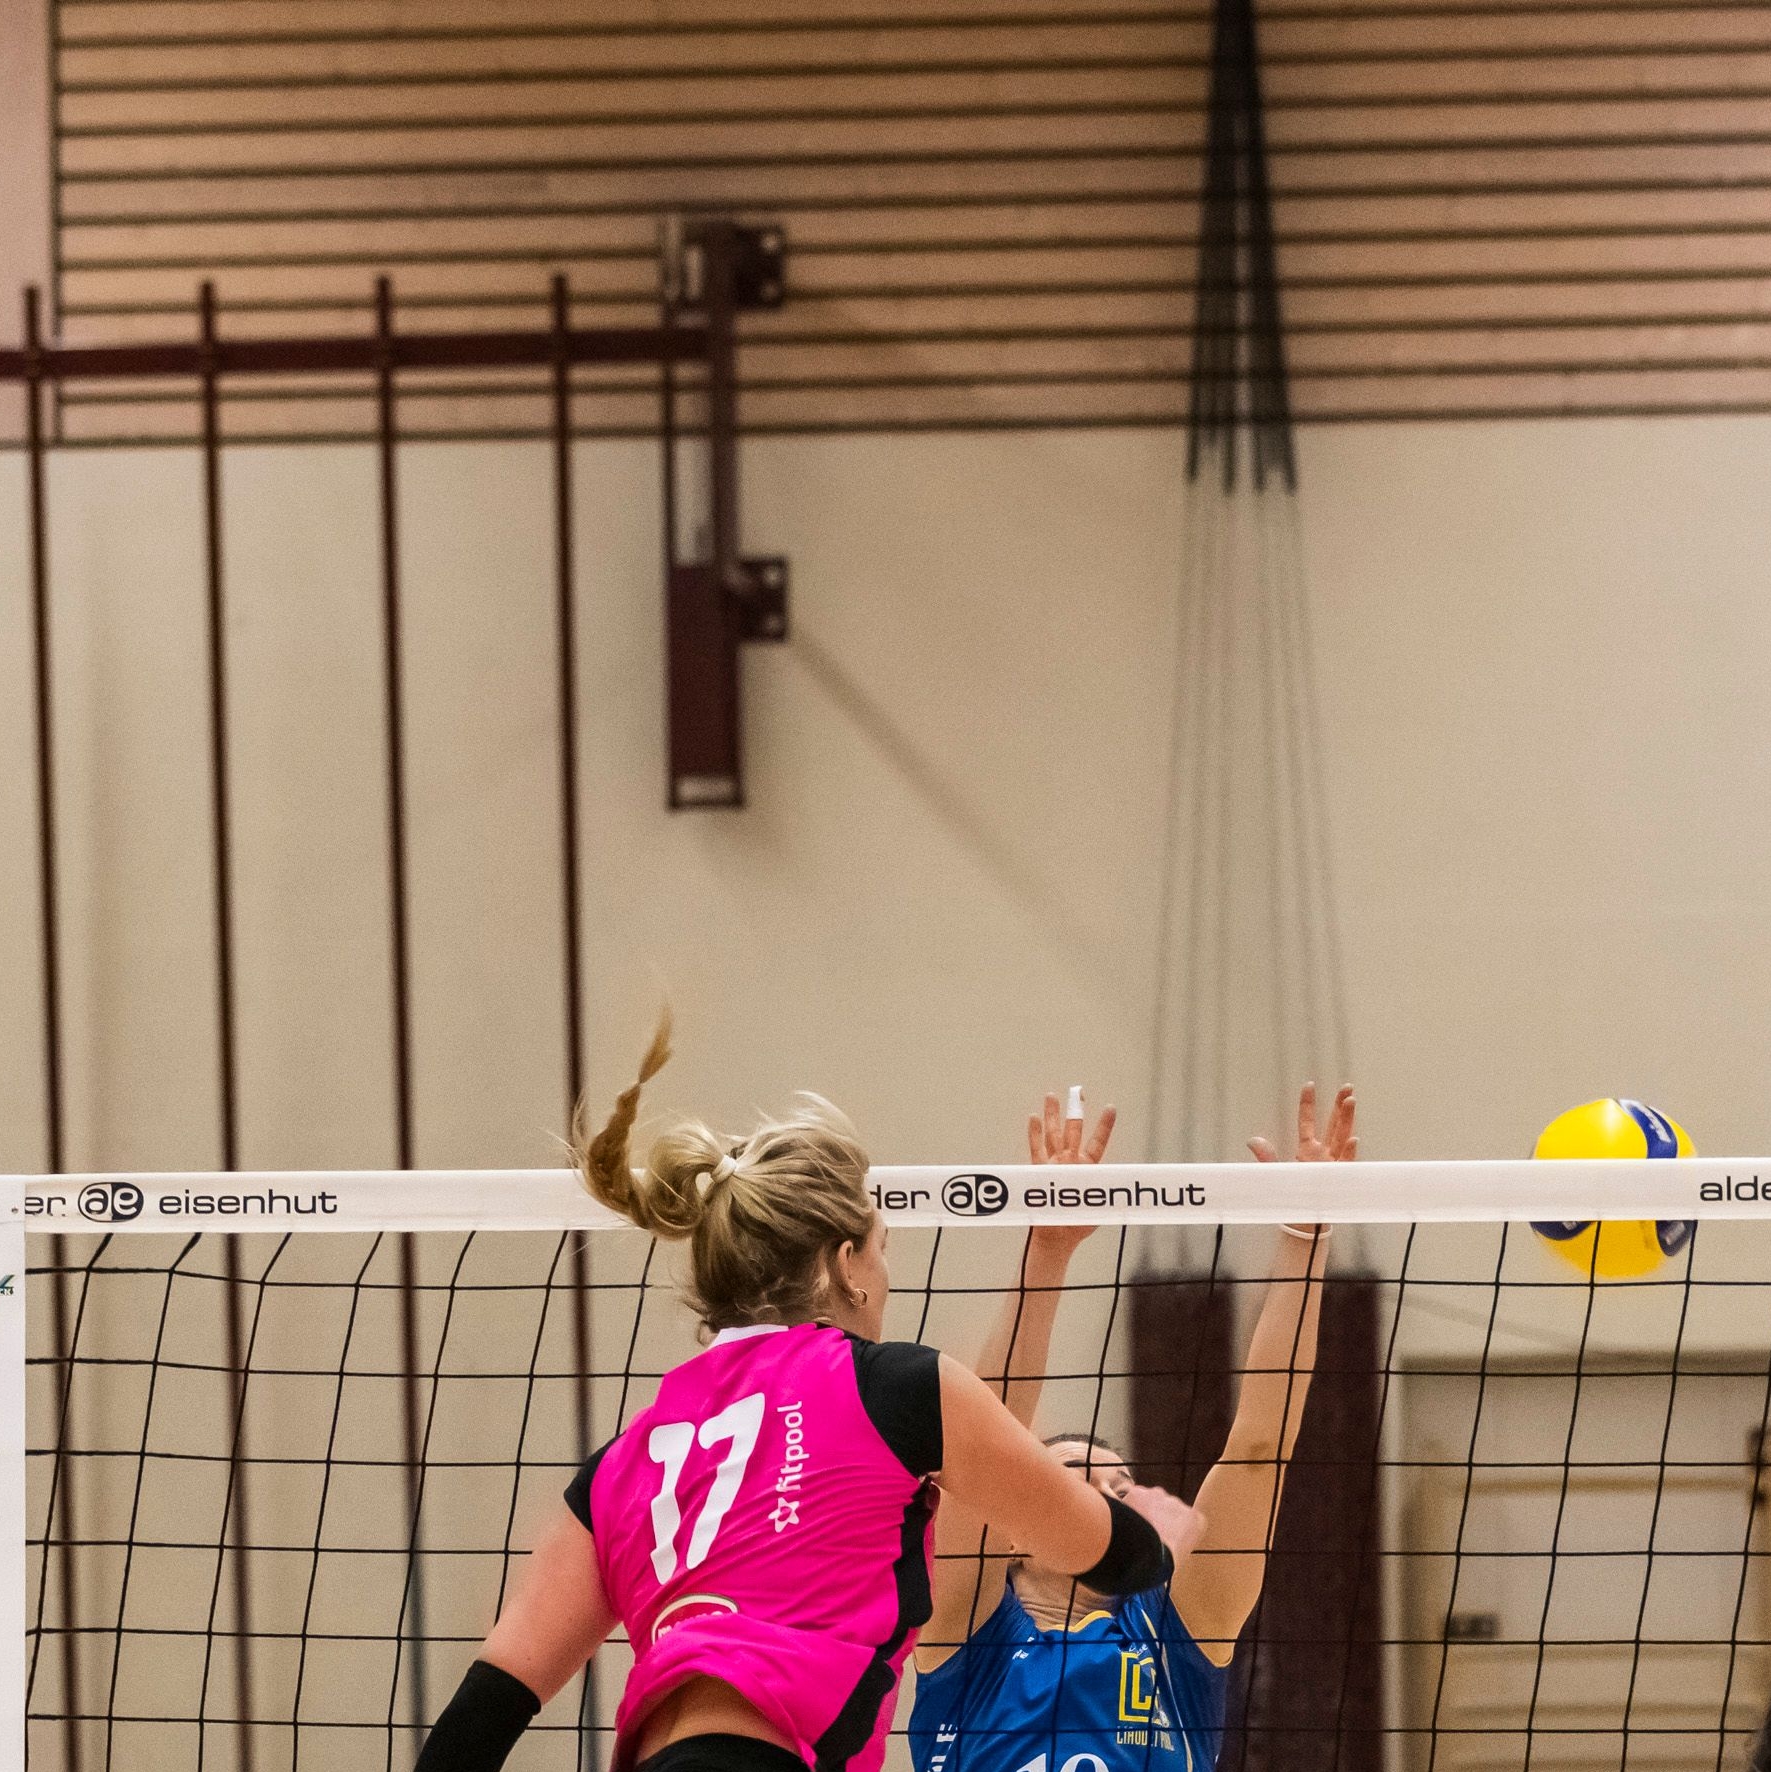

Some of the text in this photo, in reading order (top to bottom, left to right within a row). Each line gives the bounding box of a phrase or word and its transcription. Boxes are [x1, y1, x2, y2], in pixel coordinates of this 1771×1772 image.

[159, 1189, 337, 1214] eisenhut
[1024, 1182, 1206, 1208] eisenhut
[775, 1400, 811, 1494] fitpool
[648, 1392, 766, 1586] 17
